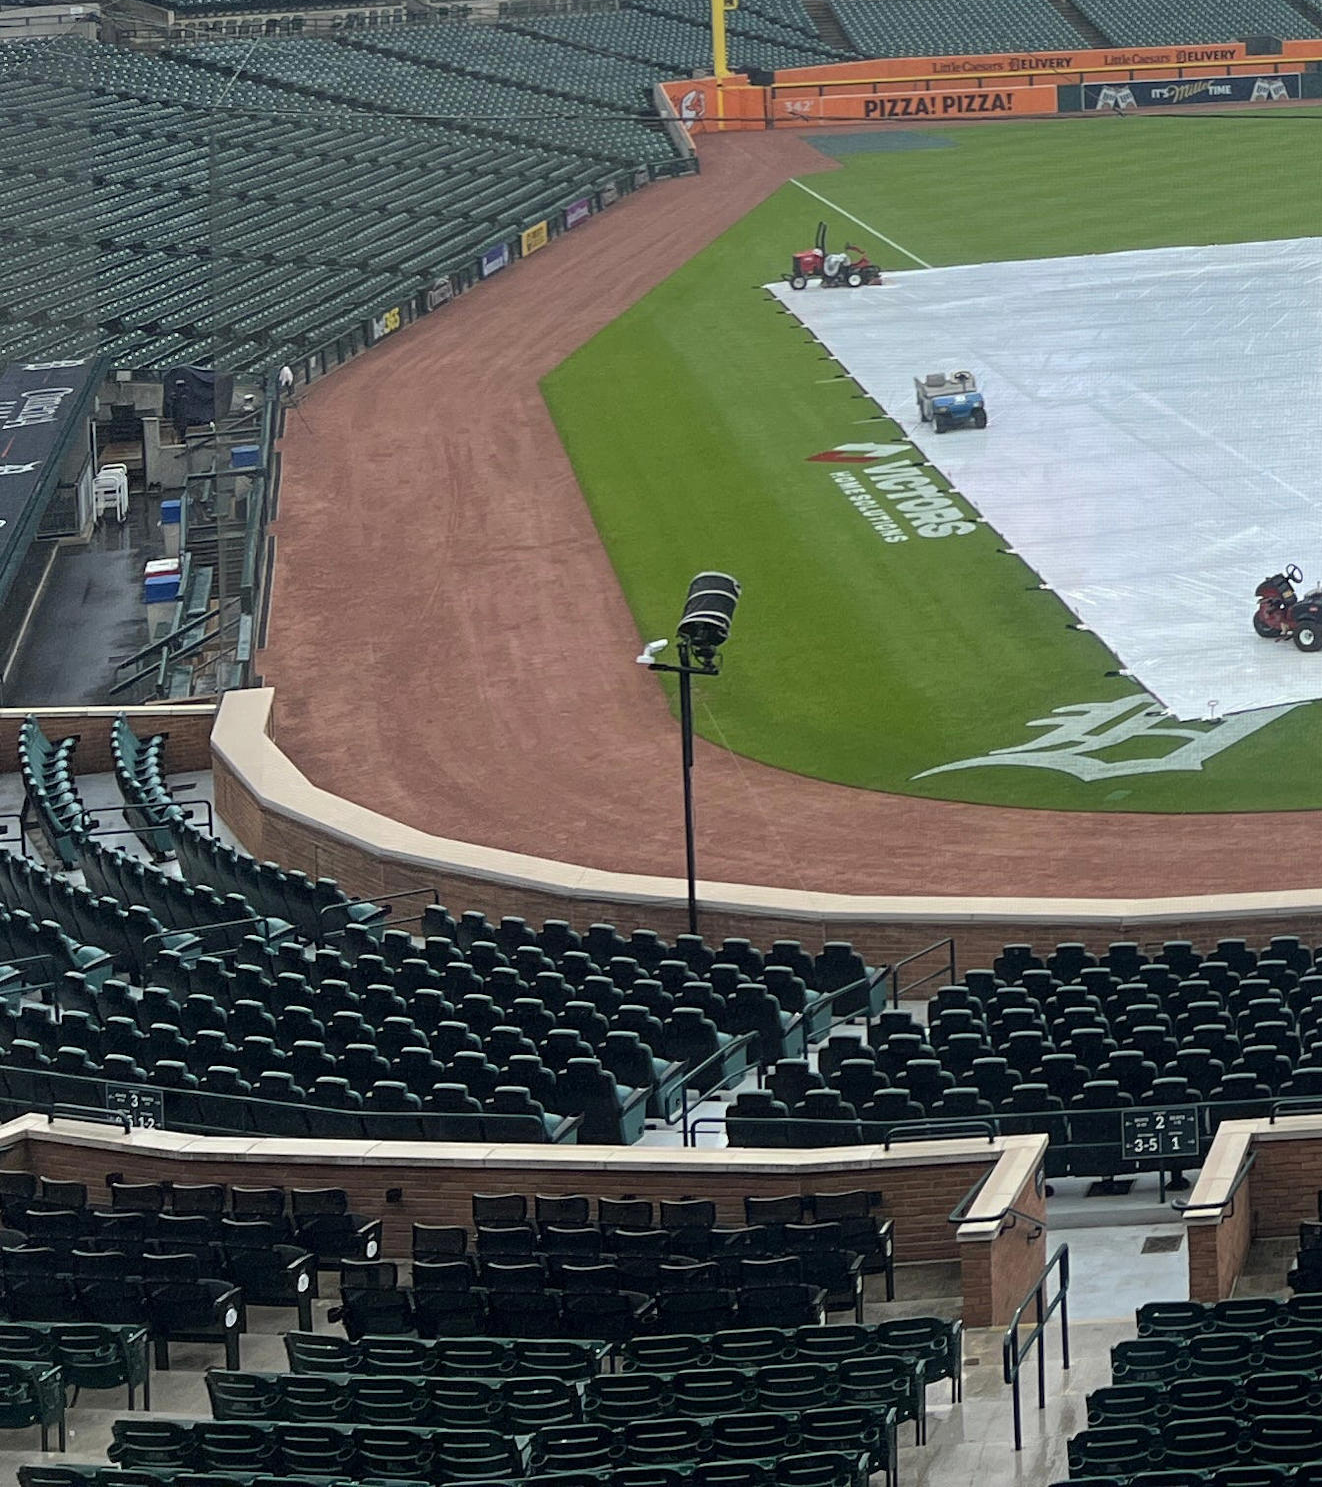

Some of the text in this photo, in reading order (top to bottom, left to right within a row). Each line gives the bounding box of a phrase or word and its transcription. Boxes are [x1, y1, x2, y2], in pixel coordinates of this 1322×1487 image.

[1151, 88, 1169, 99] IT'S
[1208, 84, 1232, 96] TIME
[864, 93, 1013, 117] PIZZA! PIZZA!
[863, 459, 977, 538] VICTORS
[829, 470, 909, 544] HOME SOLUTIONS
[130, 1094, 139, 1108] 3
[1155, 1115, 1166, 1130] 2
[1134, 1136, 1180, 1152] 3-5 1
